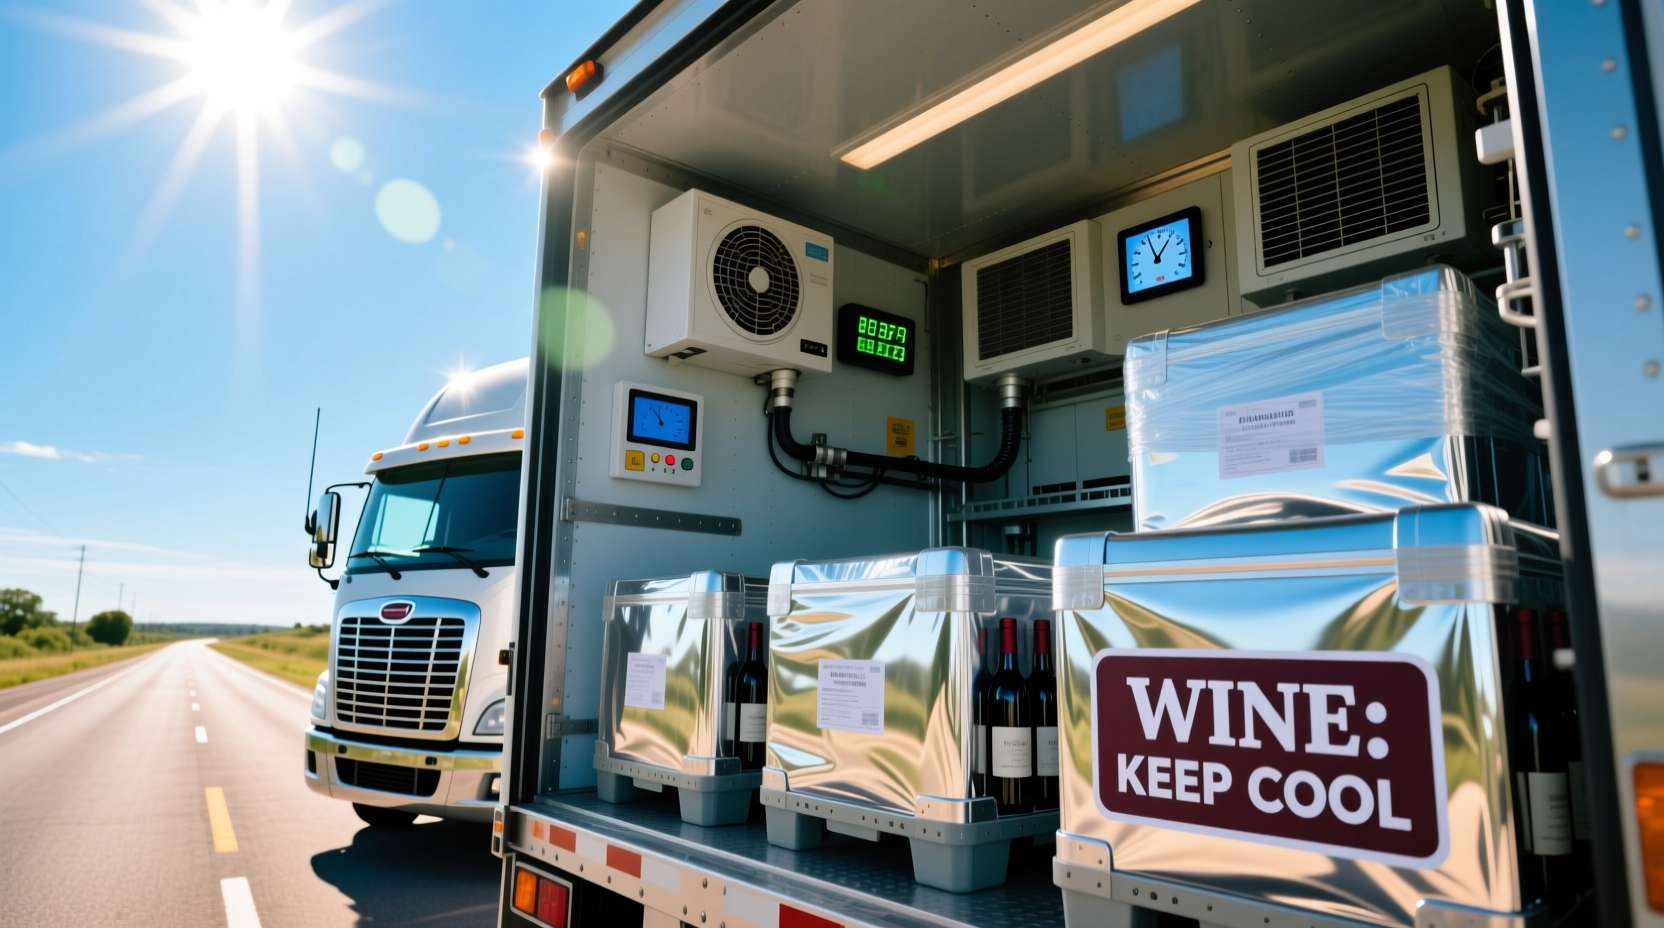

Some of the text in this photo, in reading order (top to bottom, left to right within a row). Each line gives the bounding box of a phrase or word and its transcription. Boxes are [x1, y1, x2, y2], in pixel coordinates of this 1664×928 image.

[1126, 676, 1390, 760] WINE:
[1117, 753, 1412, 832] KEEP COOL
